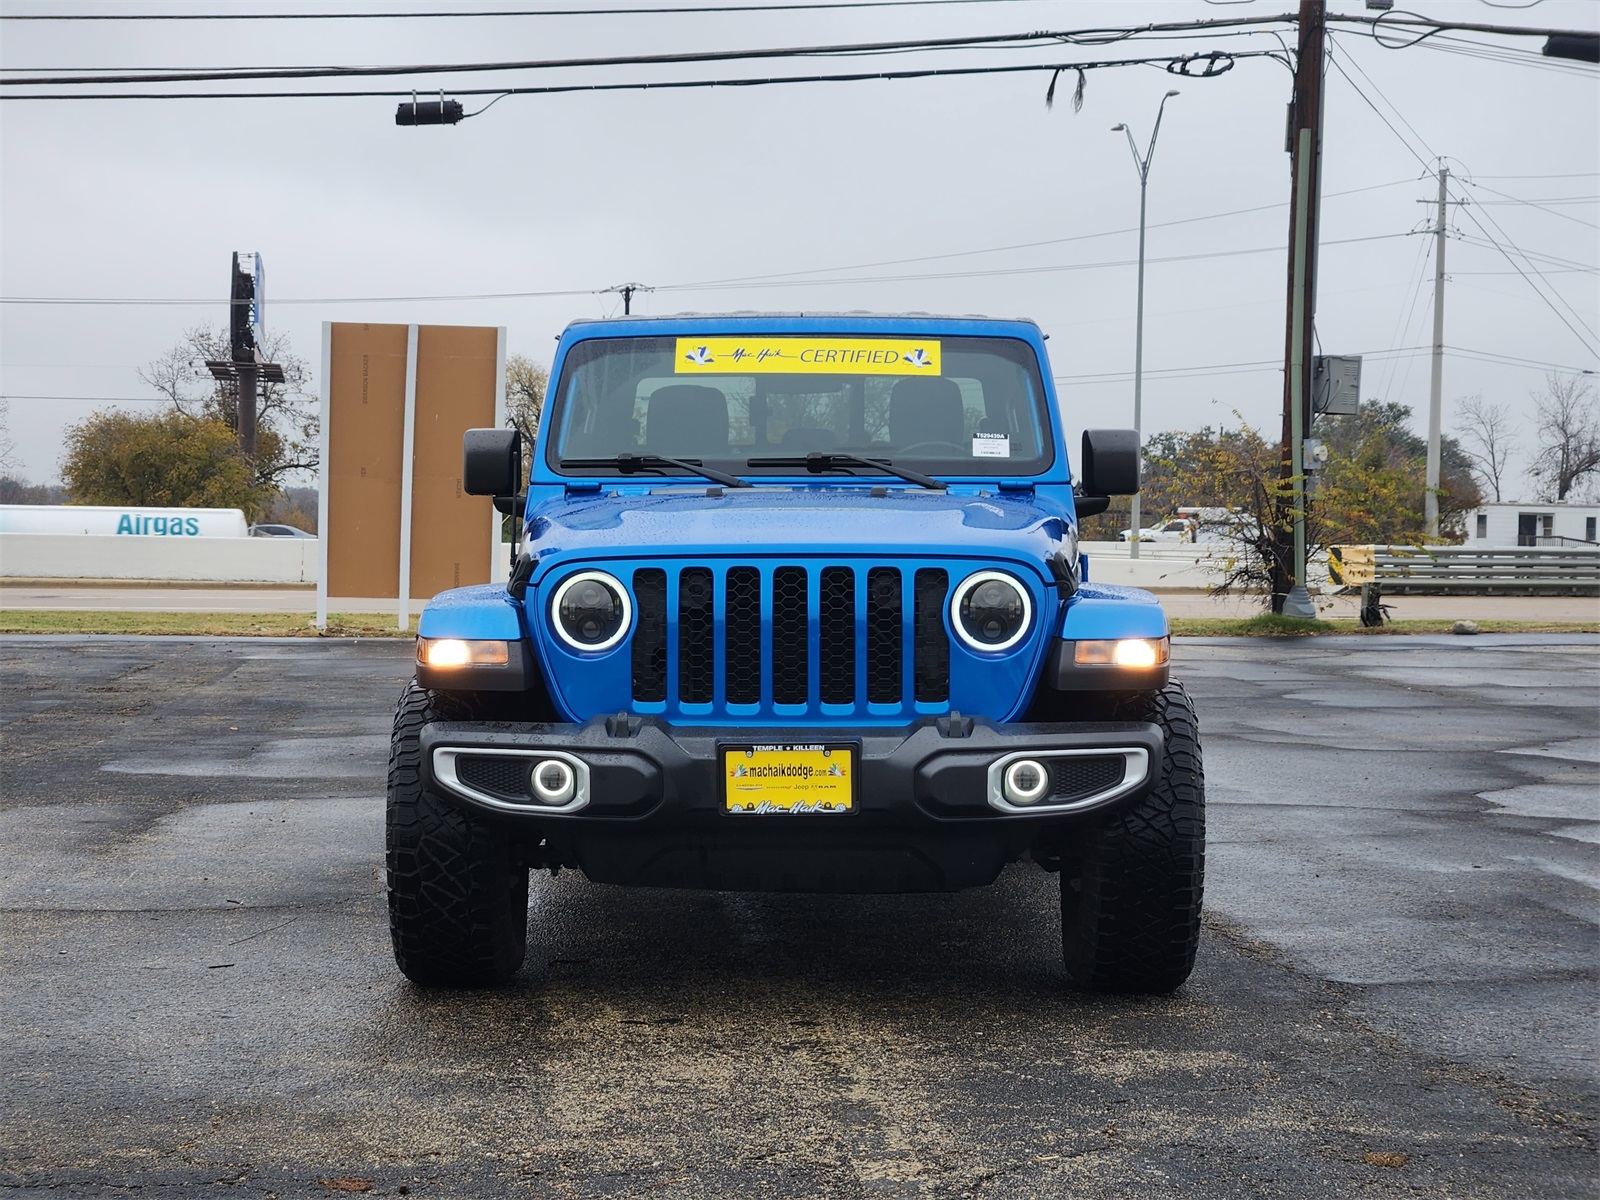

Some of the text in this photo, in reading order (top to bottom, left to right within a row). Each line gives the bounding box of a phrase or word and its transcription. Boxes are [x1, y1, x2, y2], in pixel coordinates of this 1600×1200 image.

[732, 348, 899, 364] Mac Haik CERTIFIED
[116, 514, 199, 536] Airgas
[749, 763, 827, 779] machaikdodge.com
[754, 800, 824, 814] Mac Haik
